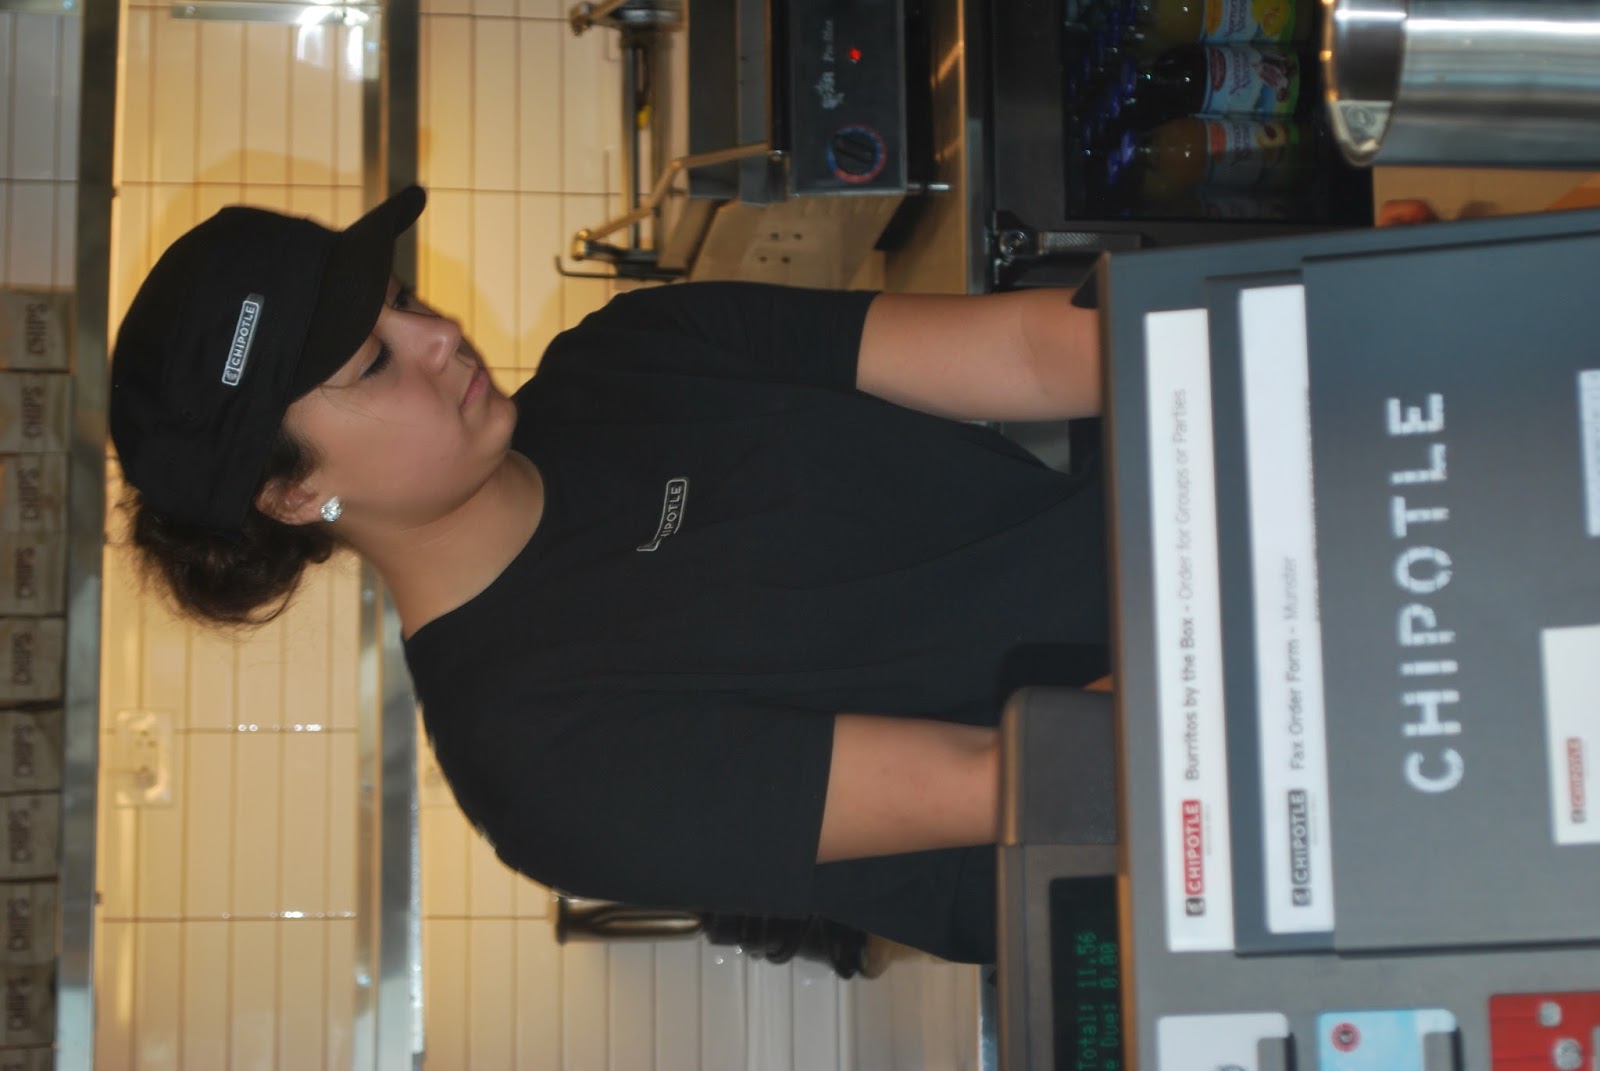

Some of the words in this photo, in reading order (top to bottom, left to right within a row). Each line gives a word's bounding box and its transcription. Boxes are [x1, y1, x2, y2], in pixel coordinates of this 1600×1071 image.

[25, 303, 47, 356] CHIPS
[230, 305, 256, 367] CHIPOTLE
[21, 387, 43, 439] CHIPS
[1171, 388, 1188, 443] Parties
[1175, 448, 1189, 465] or
[18, 467, 41, 521] CHIPS
[1174, 468, 1192, 522] Groups
[1175, 529, 1192, 550] for
[14, 548, 36, 599] CHIPS
[1177, 555, 1194, 600] Order
[1282, 556, 1299, 620] Munster
[1386, 392, 1465, 793] CHIPOTLE
[10, 632, 33, 685] CHIPS
[1180, 617, 1195, 649] Box
[1180, 655, 1197, 682] the
[1285, 639, 1301, 682] Form
[1183, 686, 1199, 707] by
[1285, 688, 1304, 735] Order
[1184, 711, 1200, 781] Burritos
[1288, 741, 1305, 770] Fax
[1184, 802, 1202, 892] CHIPOTLE
[1289, 790, 1308, 884] CHIPOTLE
[7, 898, 30, 951] CHIPS
[1074, 932, 1097, 988] 11.56
[1099, 942, 1118, 988] 0.00
[7, 975, 30, 1031] CHIPS
[1099, 1003, 1118, 1047] Due:
[1076, 1004, 1097, 1070] Total:
